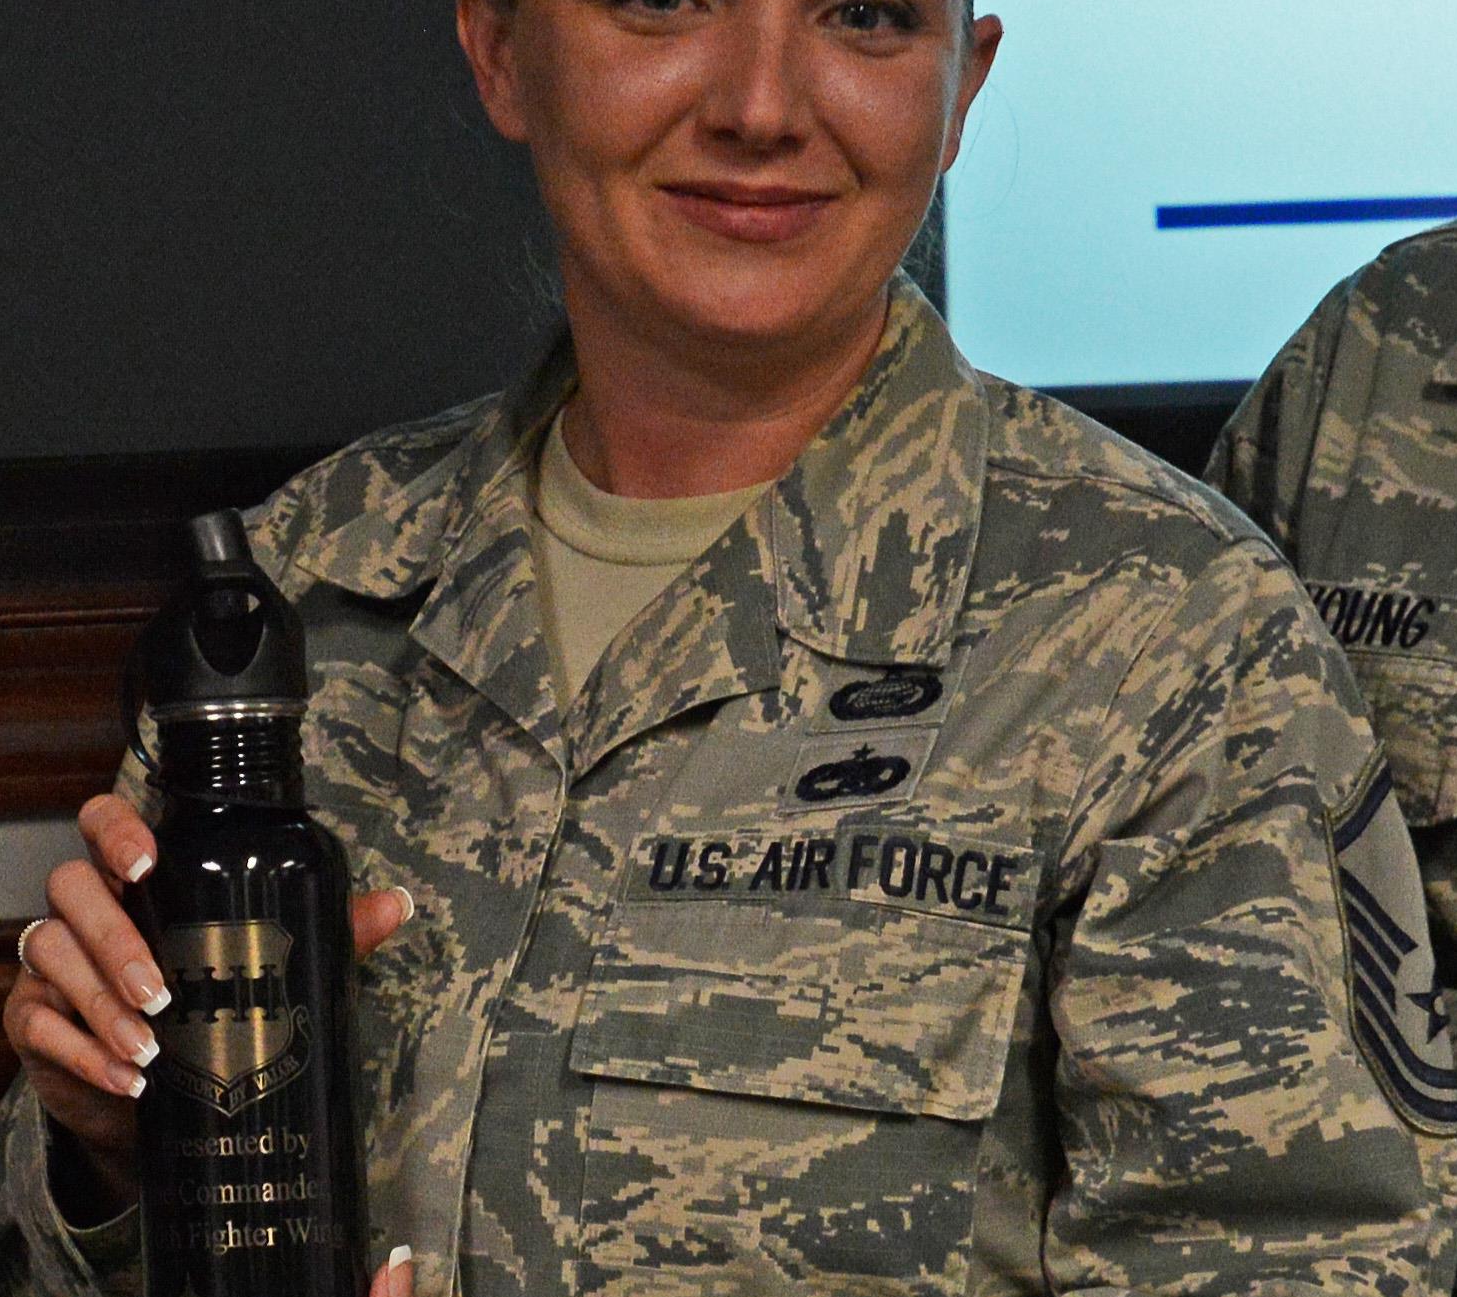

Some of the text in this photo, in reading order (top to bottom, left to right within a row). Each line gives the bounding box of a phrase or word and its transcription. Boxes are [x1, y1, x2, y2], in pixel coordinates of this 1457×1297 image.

[648, 834, 1020, 917] U.S. AIR FORCE
[163, 1125, 312, 1160] resented by
[178, 1171, 330, 1207] Commande
[188, 1219, 279, 1256] Fighter
